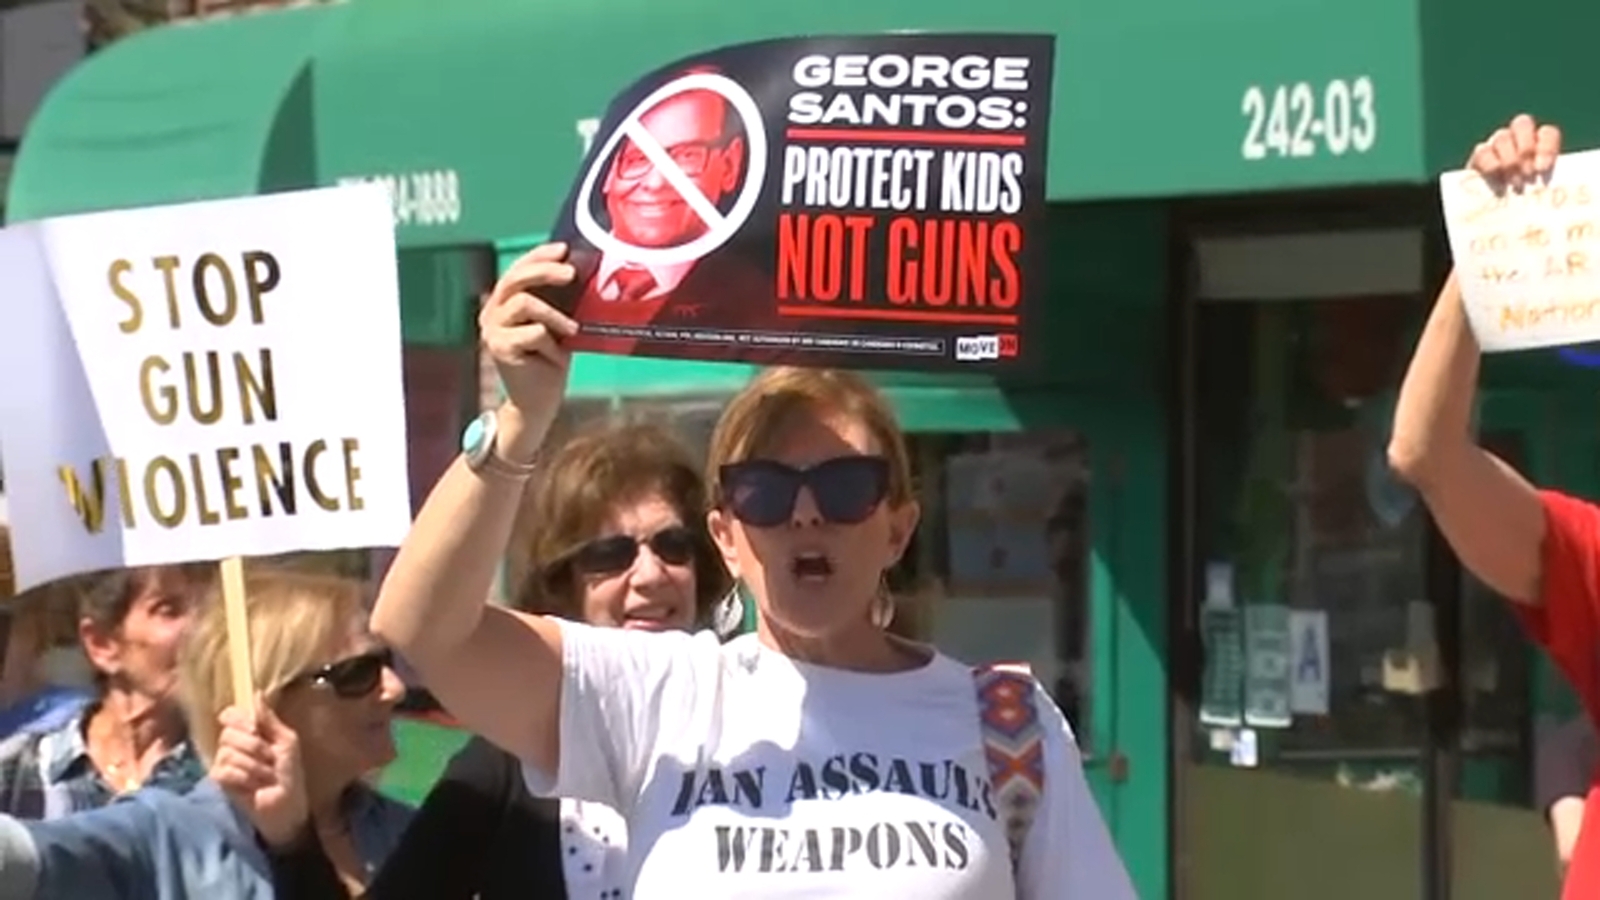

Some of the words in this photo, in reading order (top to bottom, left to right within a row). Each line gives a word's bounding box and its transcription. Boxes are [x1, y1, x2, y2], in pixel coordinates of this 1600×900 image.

[788, 92, 1027, 129] SANTOS:
[793, 55, 1029, 90] GEORGE
[1241, 76, 1376, 159] 242-03
[782, 146, 934, 209] PROTECT
[941, 151, 1022, 214] KIDS
[107, 250, 281, 334] STOP
[778, 213, 874, 301] NOT
[887, 217, 1021, 308] GUNS
[139, 348, 278, 426] GUN
[58, 437, 364, 533] VIOLENCE
[715, 821, 969, 873] WEAPONS
